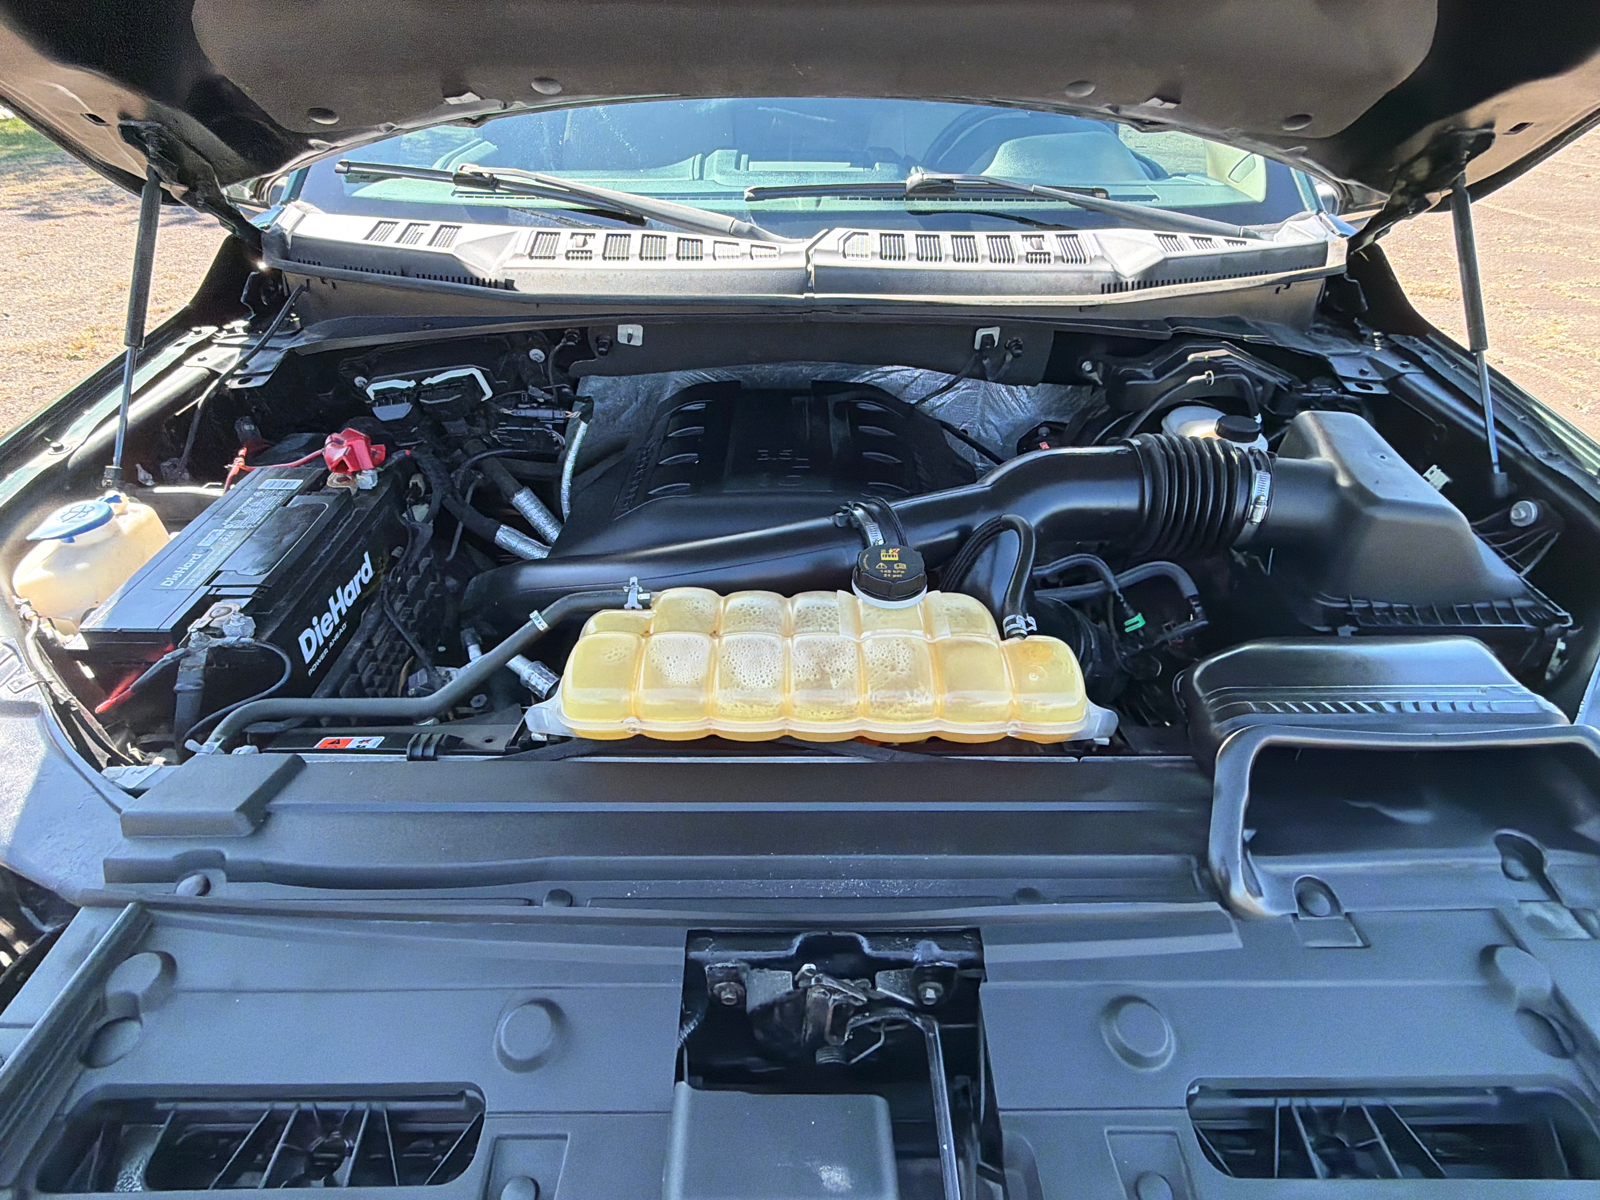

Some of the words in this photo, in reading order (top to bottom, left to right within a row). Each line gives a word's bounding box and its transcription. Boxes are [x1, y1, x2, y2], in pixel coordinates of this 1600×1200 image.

[160, 553, 203, 588] DieHard
[298, 551, 374, 664] DieHard
[307, 649, 329, 678] POWER
[329, 622, 347, 649] AHEAD
